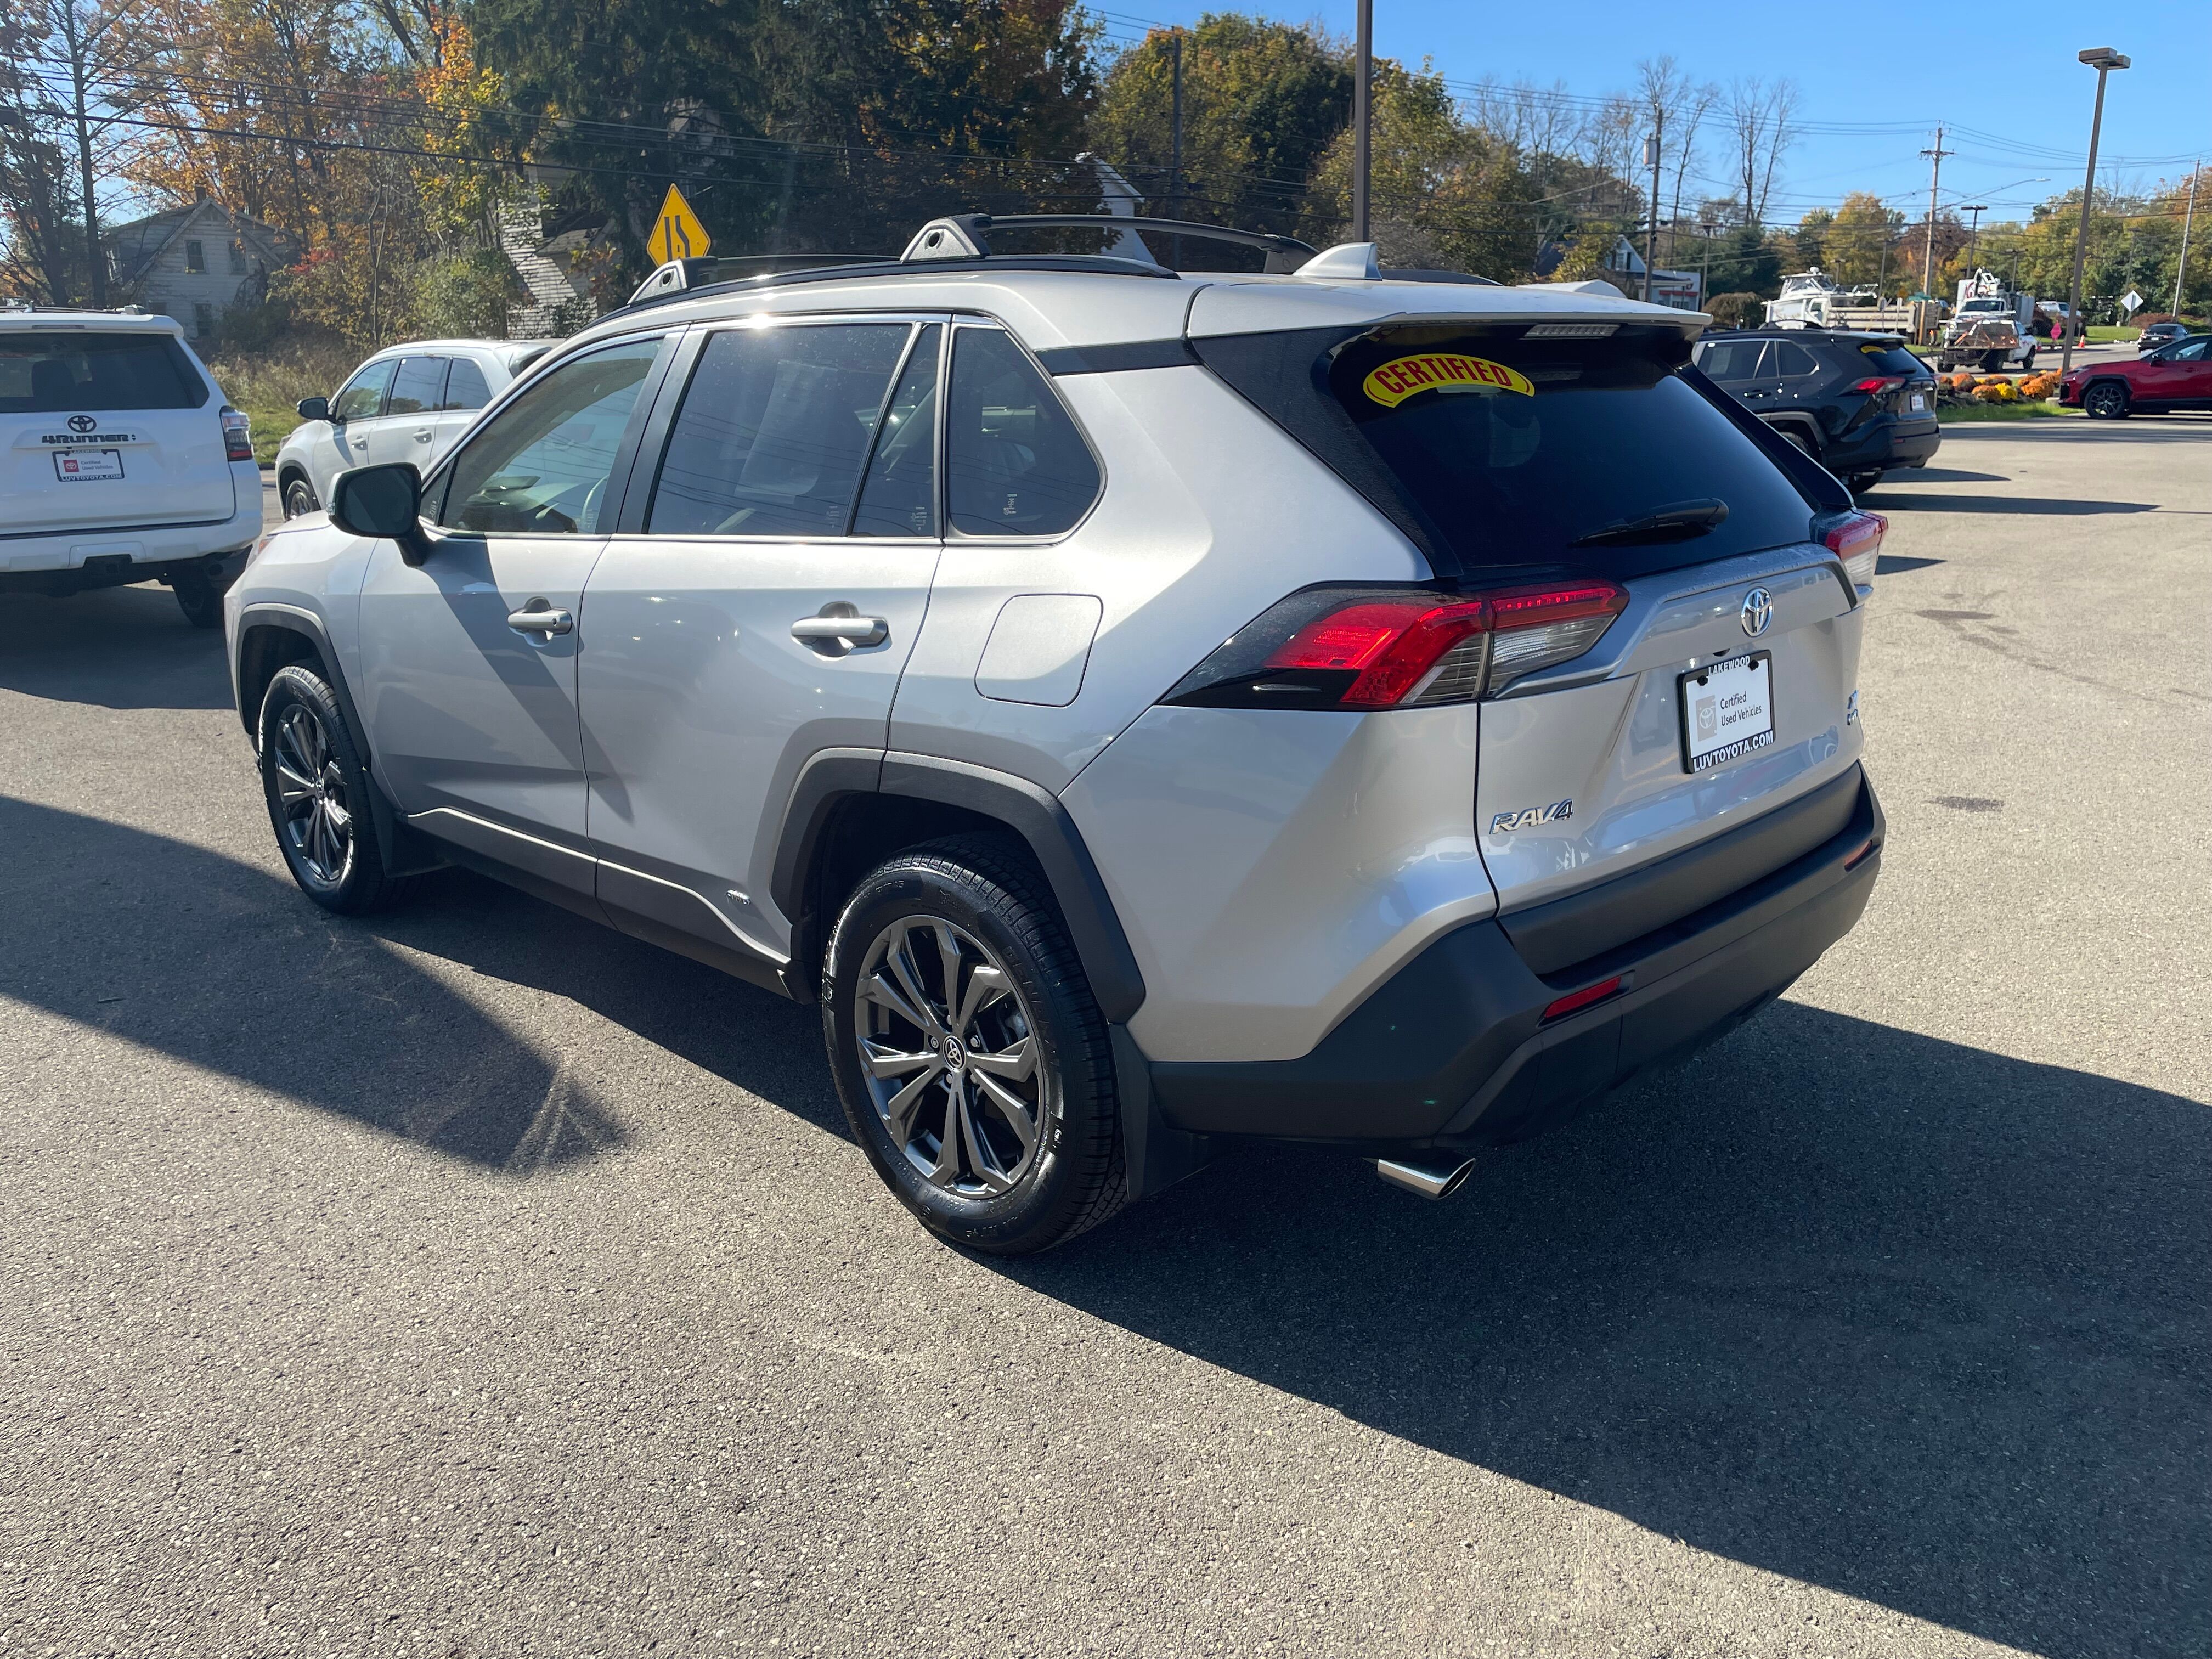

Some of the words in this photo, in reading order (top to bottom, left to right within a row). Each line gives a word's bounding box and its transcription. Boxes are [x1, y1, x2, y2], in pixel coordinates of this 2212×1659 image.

[1374, 358, 1513, 394] CERTIFIED
[1708, 655, 1751, 675] LAKEWOOD
[1720, 690, 1747, 709] Certified
[1721, 713, 1736, 726] Used
[1738, 704, 1762, 720] Vehicles
[1693, 730, 1773, 772] LUVTOYOTA.COM
[1489, 798, 1575, 834] RAV4
